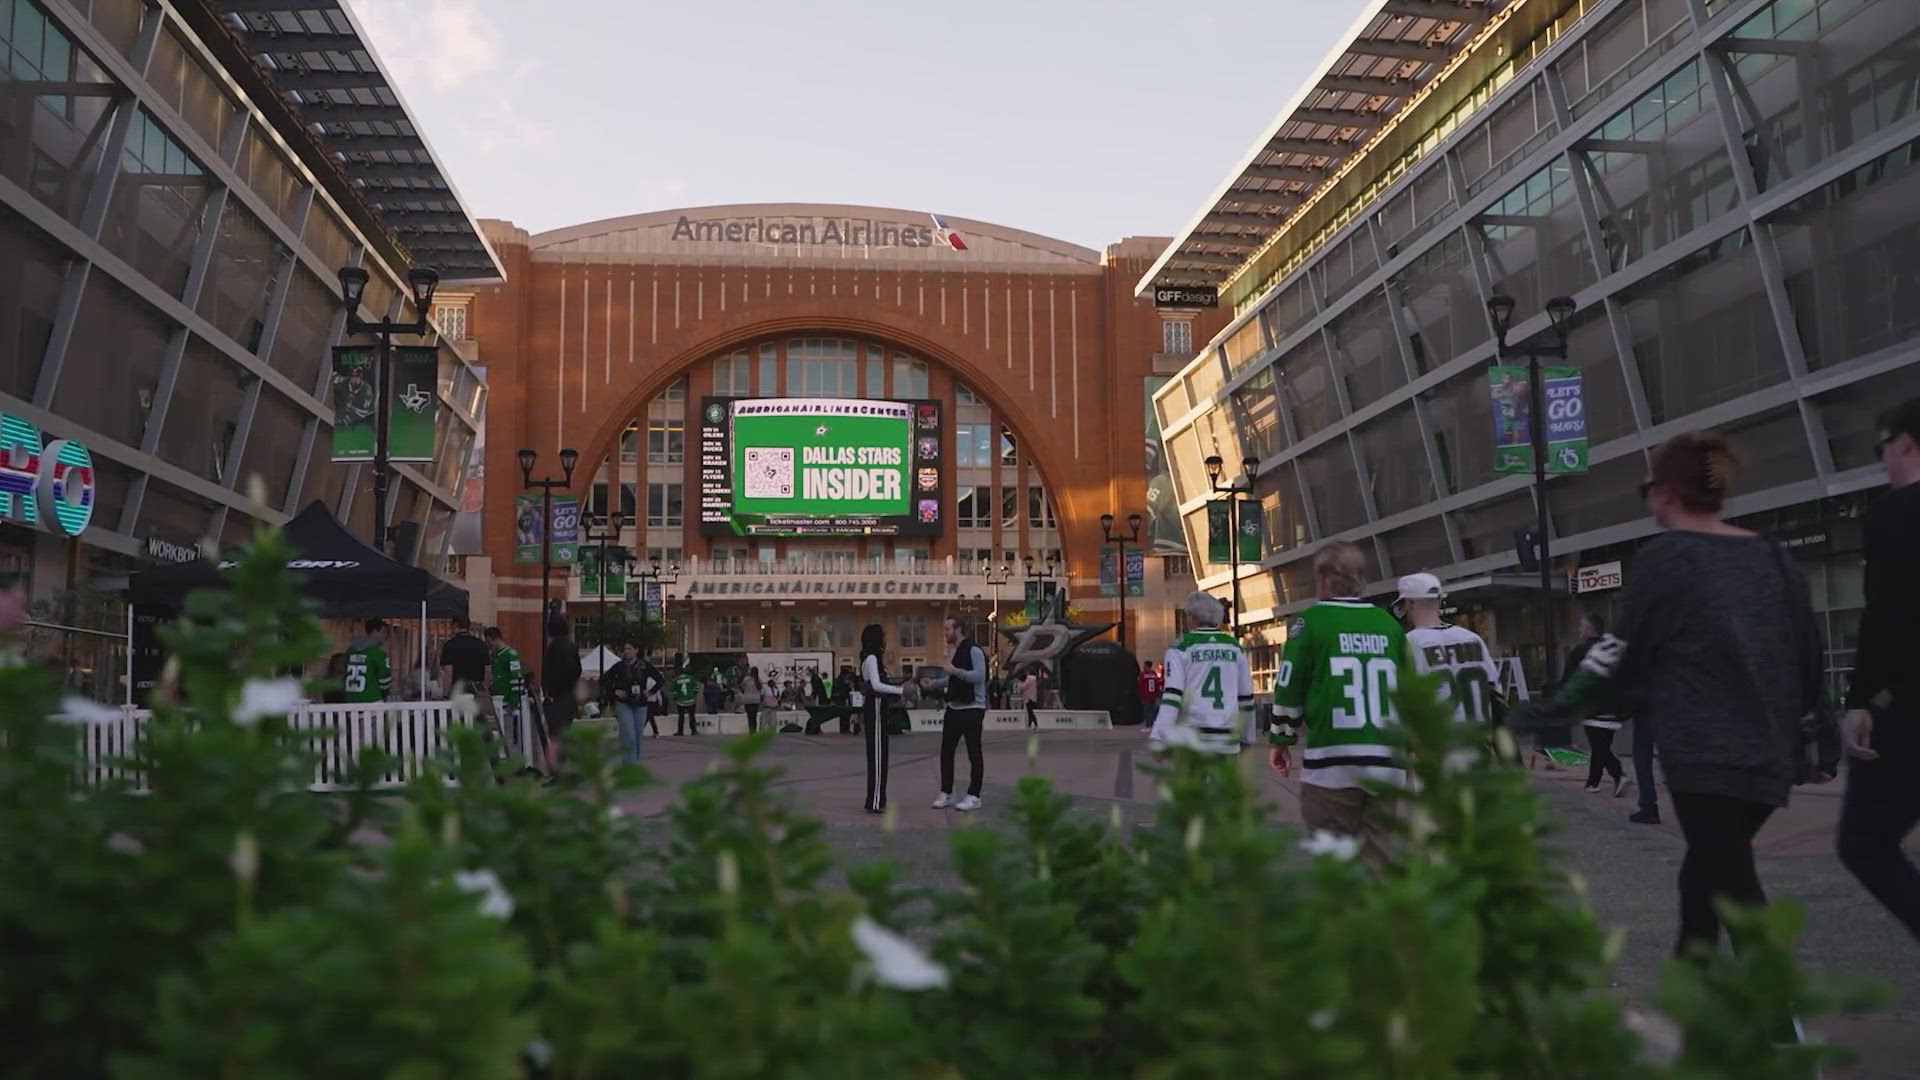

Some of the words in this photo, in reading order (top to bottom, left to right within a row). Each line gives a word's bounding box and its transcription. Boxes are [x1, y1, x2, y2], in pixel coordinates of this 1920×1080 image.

[1548, 397, 1582, 419] GO
[803, 447, 855, 464] DALLAS
[858, 447, 901, 464] STARS
[802, 468, 902, 500] INSIDER
[553, 515, 577, 529] GO
[1580, 574, 1620, 588] TICKETS
[1191, 648, 1237, 662] HEISKANEN
[1338, 633, 1389, 655] BISHOP
[346, 664, 368, 692] 25
[1201, 666, 1224, 710] 4
[1329, 656, 1398, 729] 30
